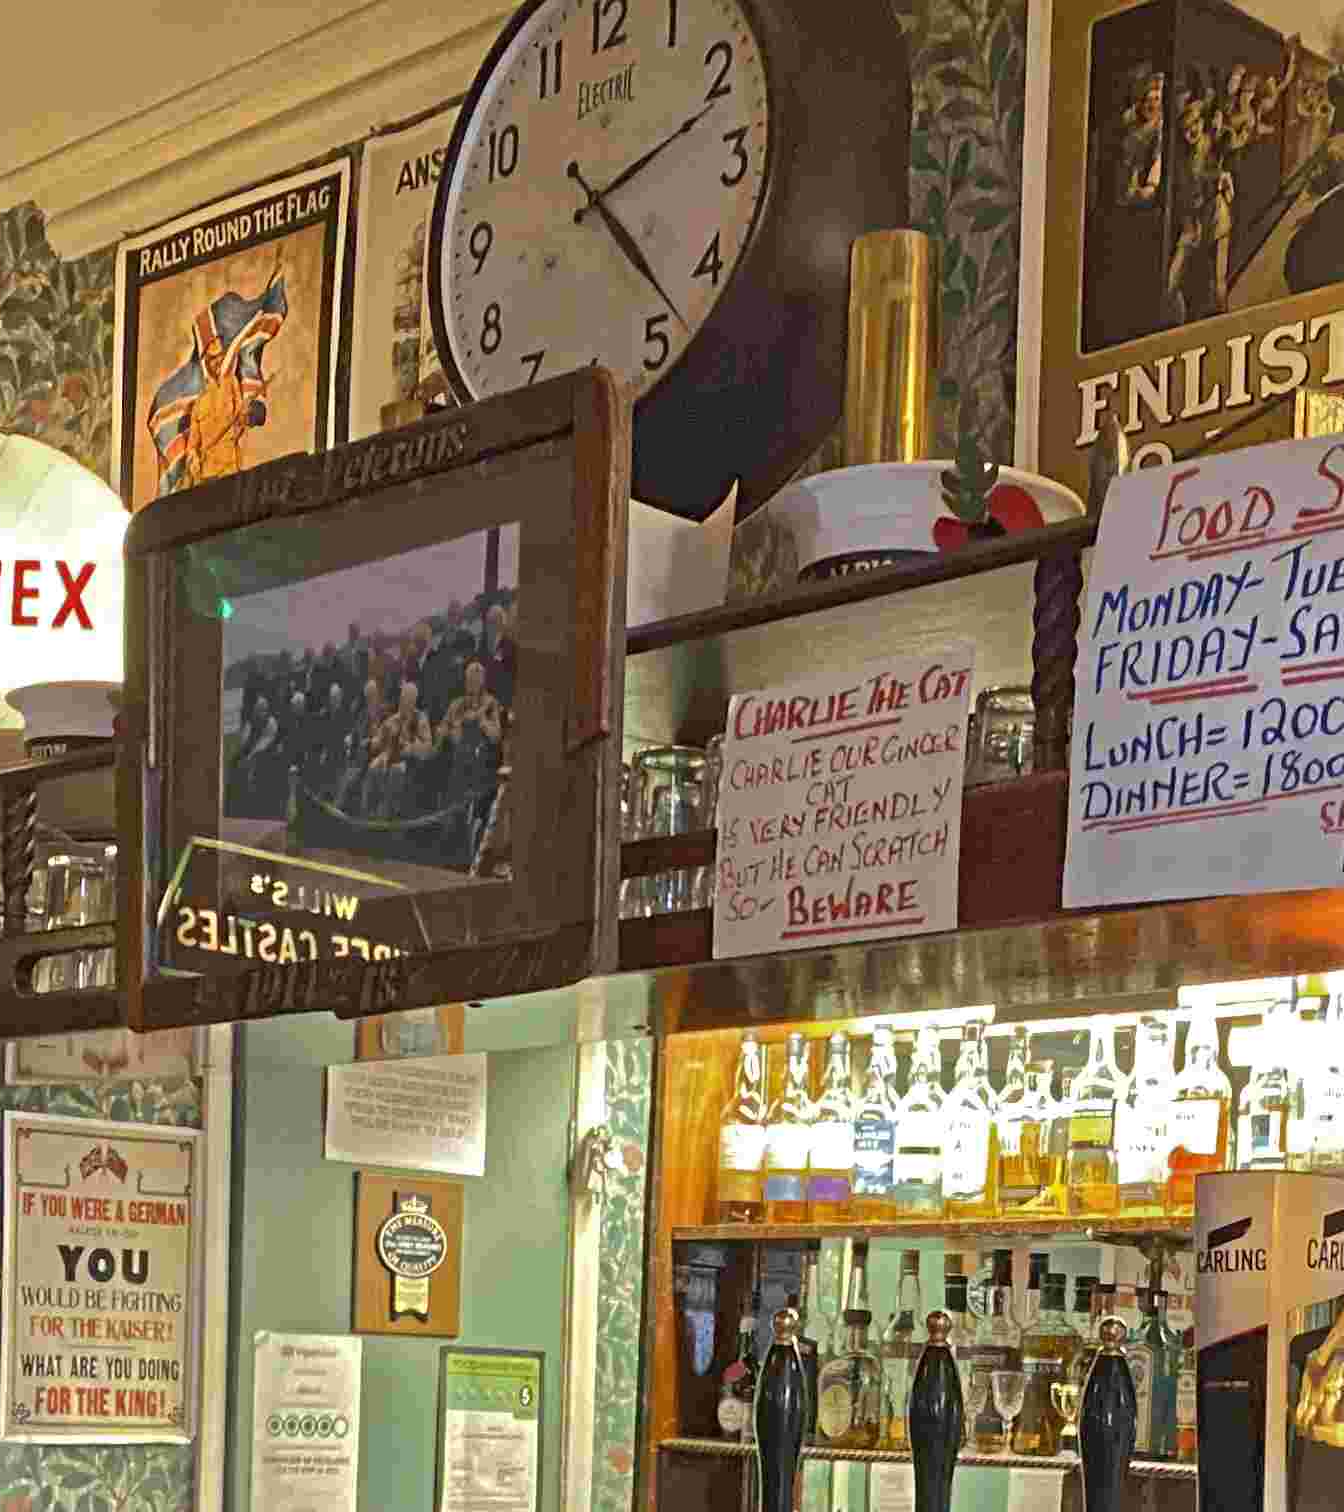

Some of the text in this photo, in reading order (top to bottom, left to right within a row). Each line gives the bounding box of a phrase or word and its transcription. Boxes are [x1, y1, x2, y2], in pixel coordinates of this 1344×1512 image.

[536, 39, 564, 101] 11
[704, 40, 733, 103] 2
[487, 124, 520, 184] 10
[719, 125, 750, 187] 3
[139, 186, 331, 277] RALLY ROUND THE FLAG
[468, 221, 494, 275] 9
[690, 231, 723, 285] 4
[479, 301, 502, 355] 8
[642, 313, 670, 370] 5
[1158, 466, 1276, 553] FOOD
[735, 664, 973, 740] CHARLIE THE CAT
[729, 726, 960, 791] CHARLIE OUR GINGER
[722, 778, 952, 850] IS VERY FRIENDLY
[807, 775, 854, 806] CAT
[719, 825, 948, 890] BUT HE CAN SCRATCH
[787, 879, 919, 926] BEWARE
[23, 1192, 185, 1225] IF YOU WERE A GERMAN
[57, 1244, 149, 1285] YOU
[1197, 1248, 1267, 1273] CARLING
[21, 1285, 182, 1313] WOULD BE FIGHTING
[29, 1315, 64, 1338] FOR
[70, 1316, 105, 1340] THE
[20, 1354, 180, 1382] WHAT ARE YOU DOING
[34, 1386, 167, 1418] FOR THE KING!
